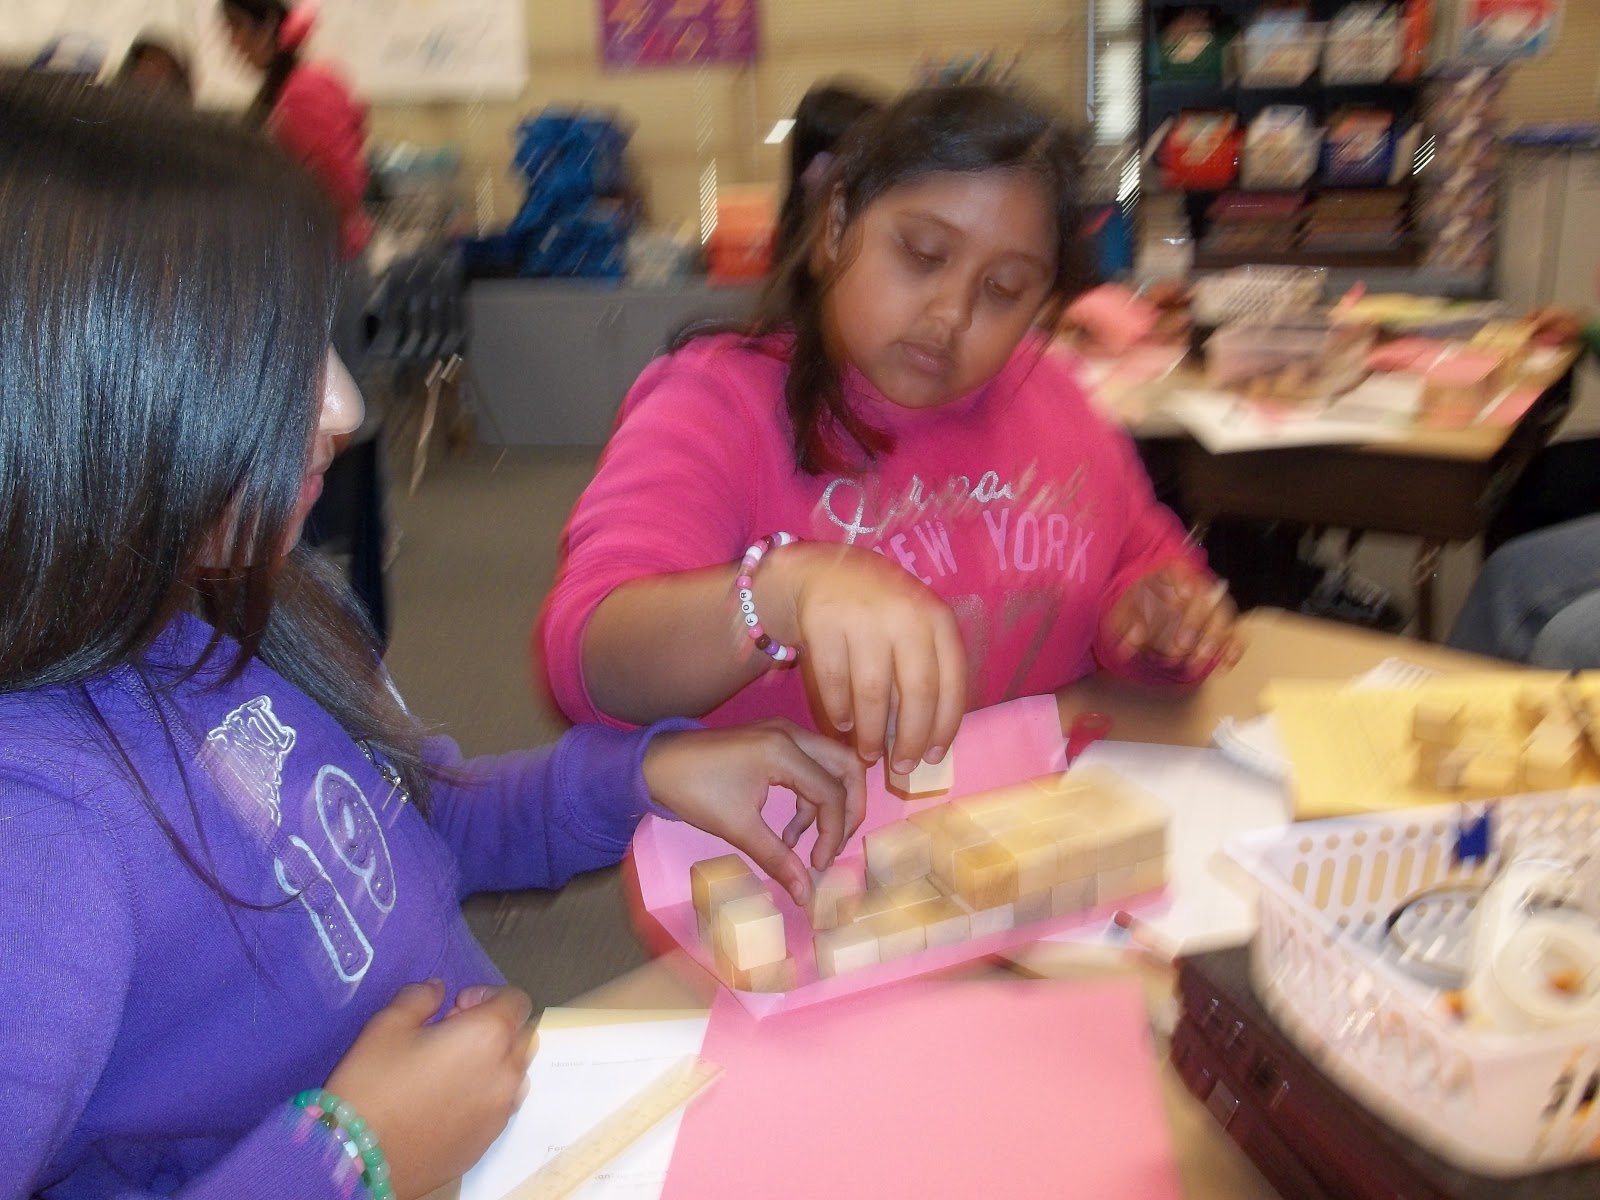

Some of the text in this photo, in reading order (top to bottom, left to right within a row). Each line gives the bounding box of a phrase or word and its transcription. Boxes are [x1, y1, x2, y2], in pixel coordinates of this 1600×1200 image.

[874, 507, 1095, 585] EW YORK
[741, 592, 754, 624] FOR
